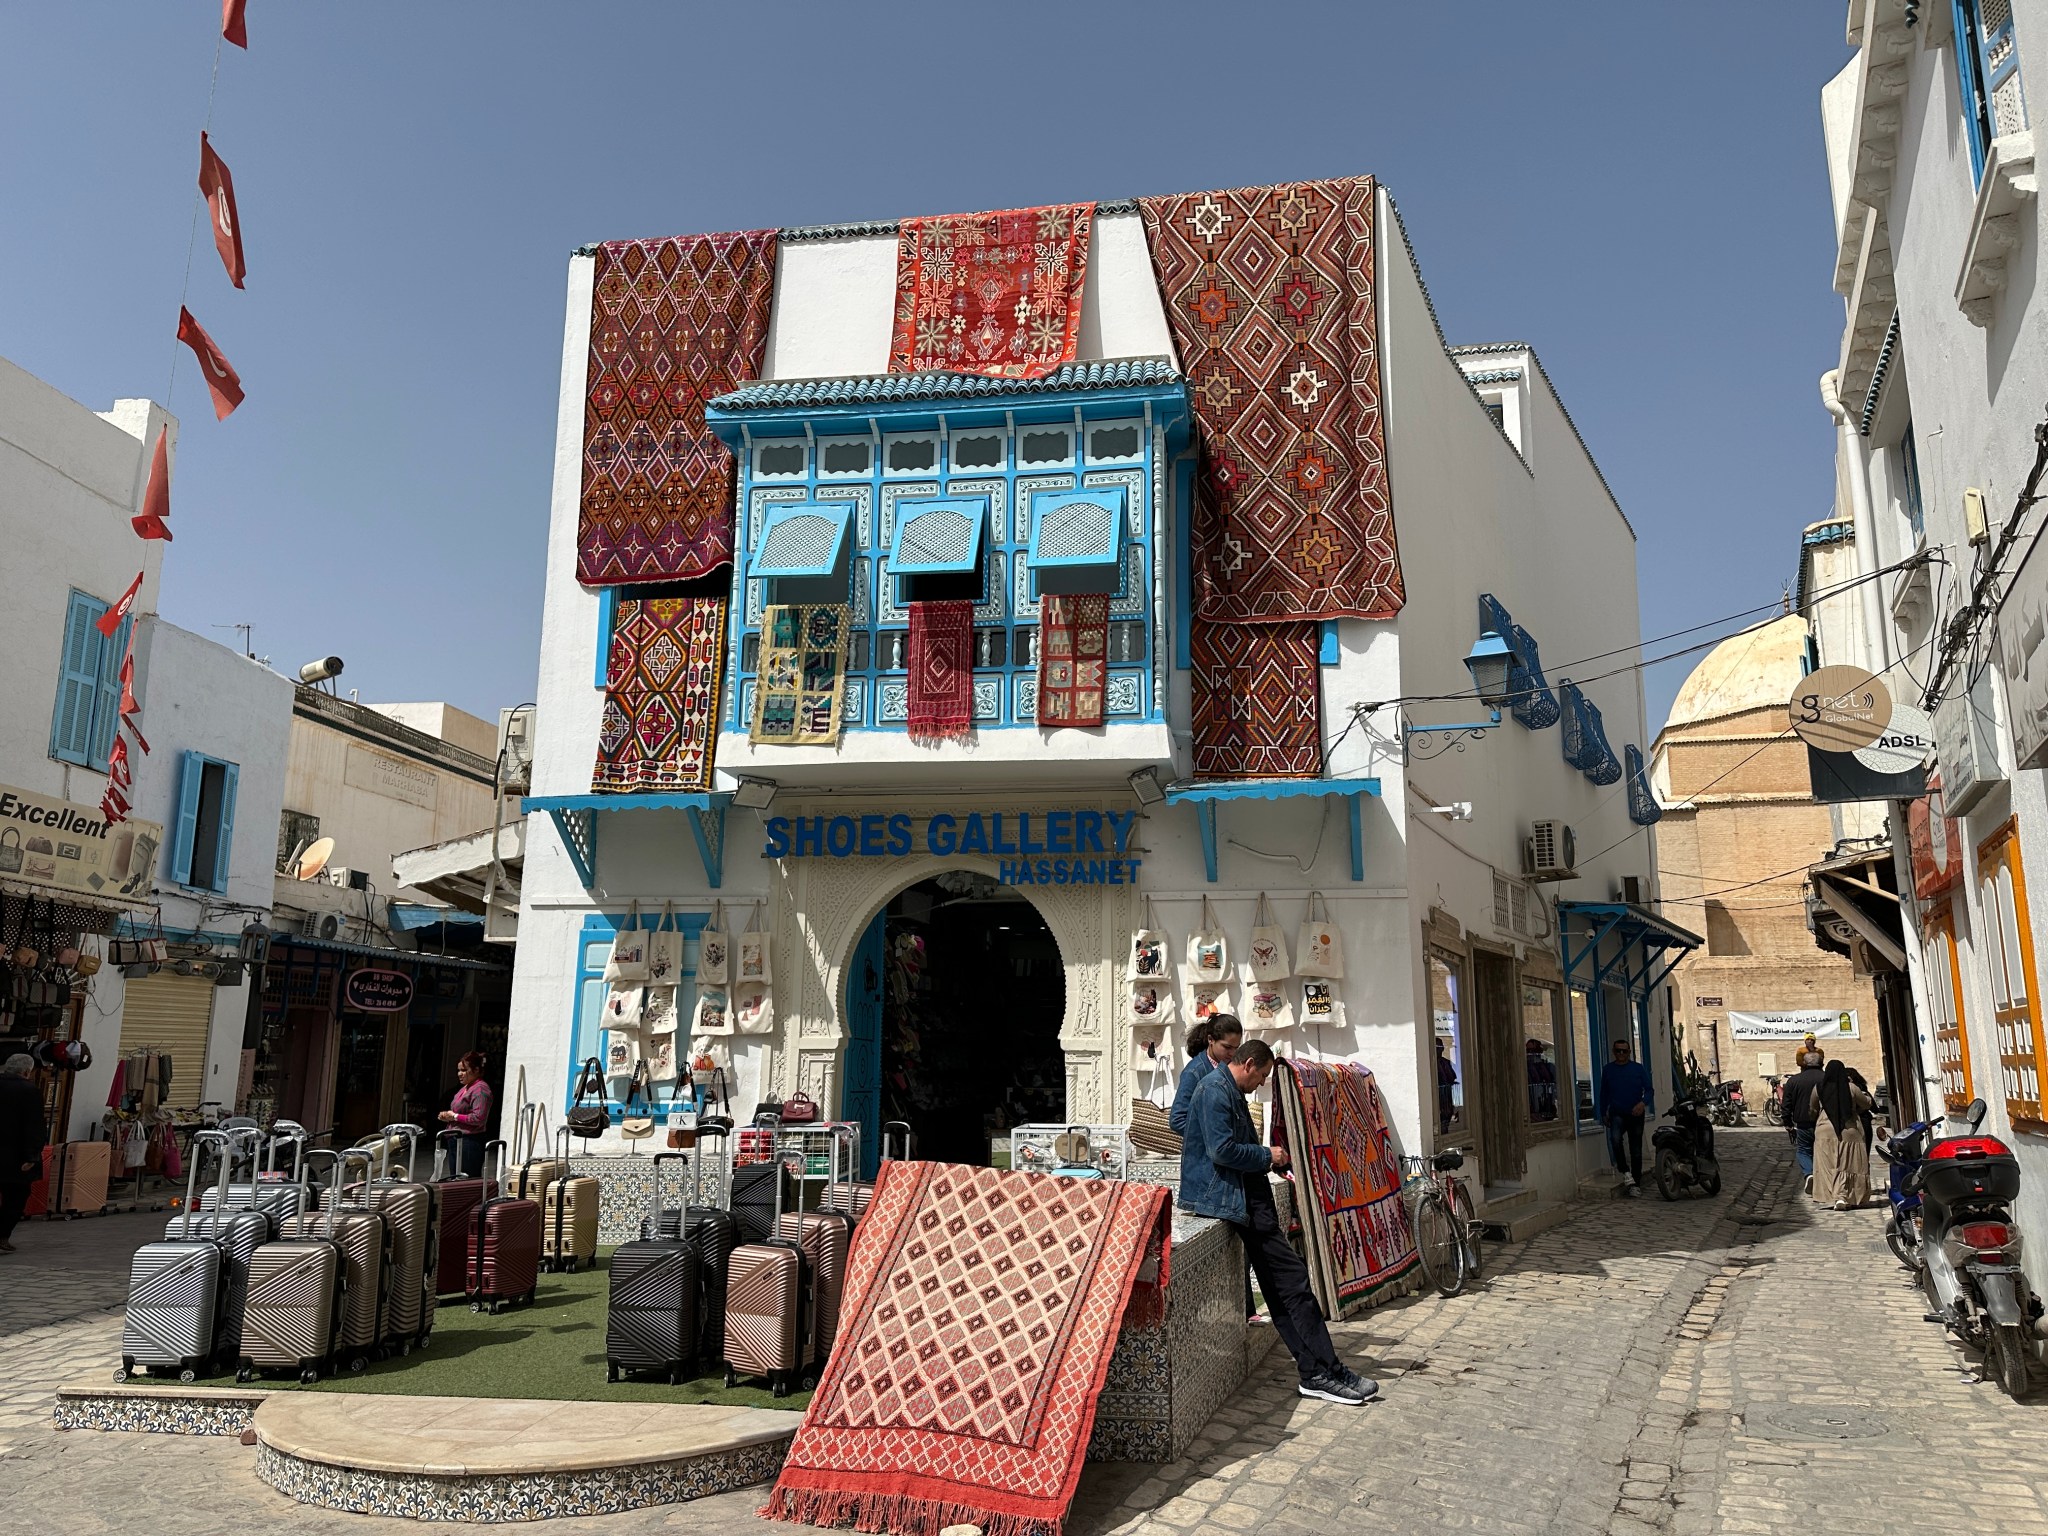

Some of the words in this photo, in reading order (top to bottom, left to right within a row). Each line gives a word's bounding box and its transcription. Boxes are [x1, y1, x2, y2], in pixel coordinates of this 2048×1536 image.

[1825, 712, 1874, 723] GlobalNet
[1878, 735, 1926, 749] ADSL
[373, 759, 436, 787] RESTAURANT
[382, 774, 428, 797] MARHABA
[0, 792, 110, 839] Excellent
[765, 813, 913, 858] SHOES
[927, 810, 1136, 856] GALLERY
[1000, 859, 1142, 886] HASSANET
